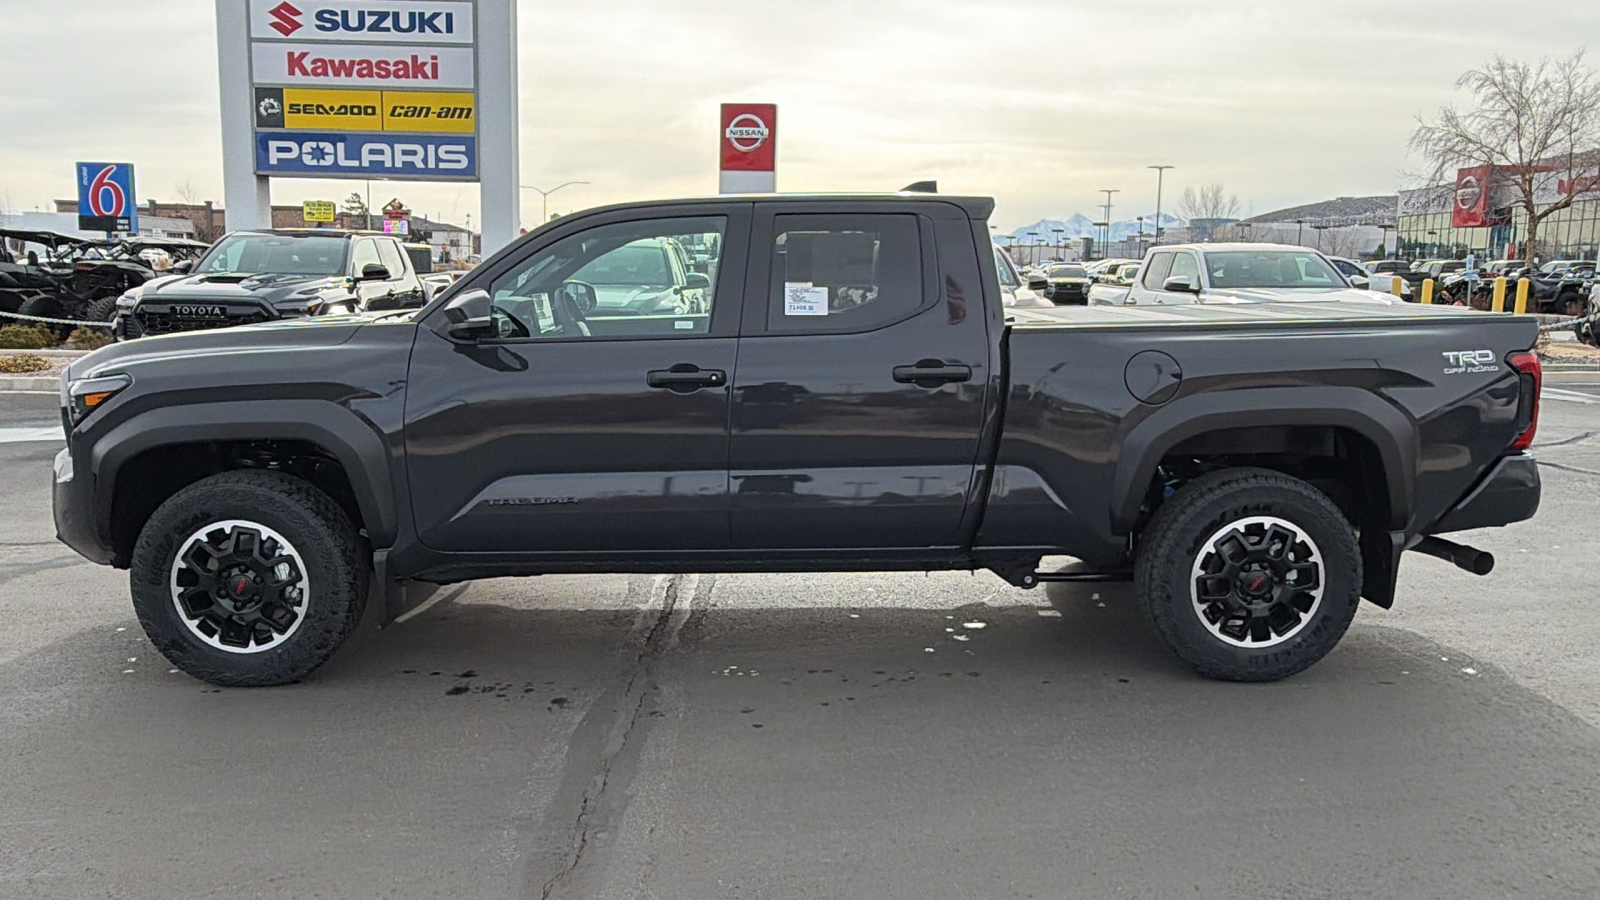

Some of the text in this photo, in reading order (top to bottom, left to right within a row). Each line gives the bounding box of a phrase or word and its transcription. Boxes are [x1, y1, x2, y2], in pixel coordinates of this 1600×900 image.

[314, 9, 454, 34] SUZUKI
[287, 51, 439, 80] Kawasaki
[389, 105, 473, 119] can-am
[729, 129, 765, 137] NISSAN
[268, 140, 469, 170] POLARIS
[88, 164, 126, 217] 6
[175, 306, 221, 315] TOYOTA
[1442, 349, 1496, 366] TRD
[484, 498, 579, 507] TACOMA
